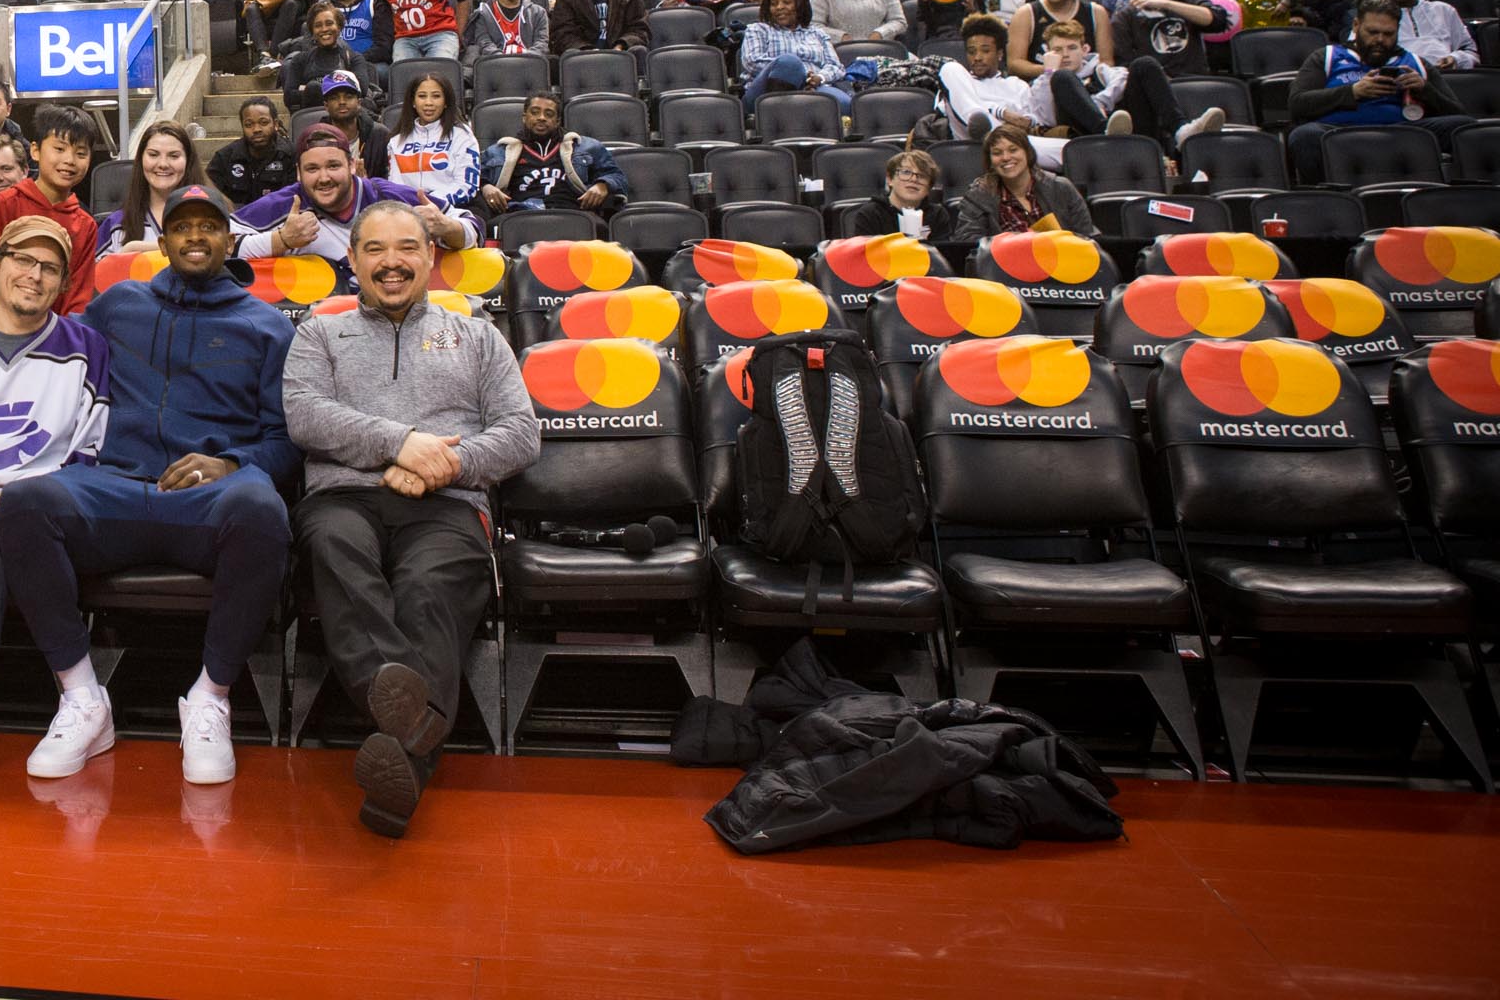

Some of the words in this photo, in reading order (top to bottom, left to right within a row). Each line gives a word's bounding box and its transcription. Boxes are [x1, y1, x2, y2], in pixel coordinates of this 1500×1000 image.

[400, 7, 426, 31] 10
[1166, 22, 1180, 35] 30
[401, 139, 453, 154] PEPSI
[518, 168, 566, 192] RAPTO
[540, 176, 557, 195] 7
